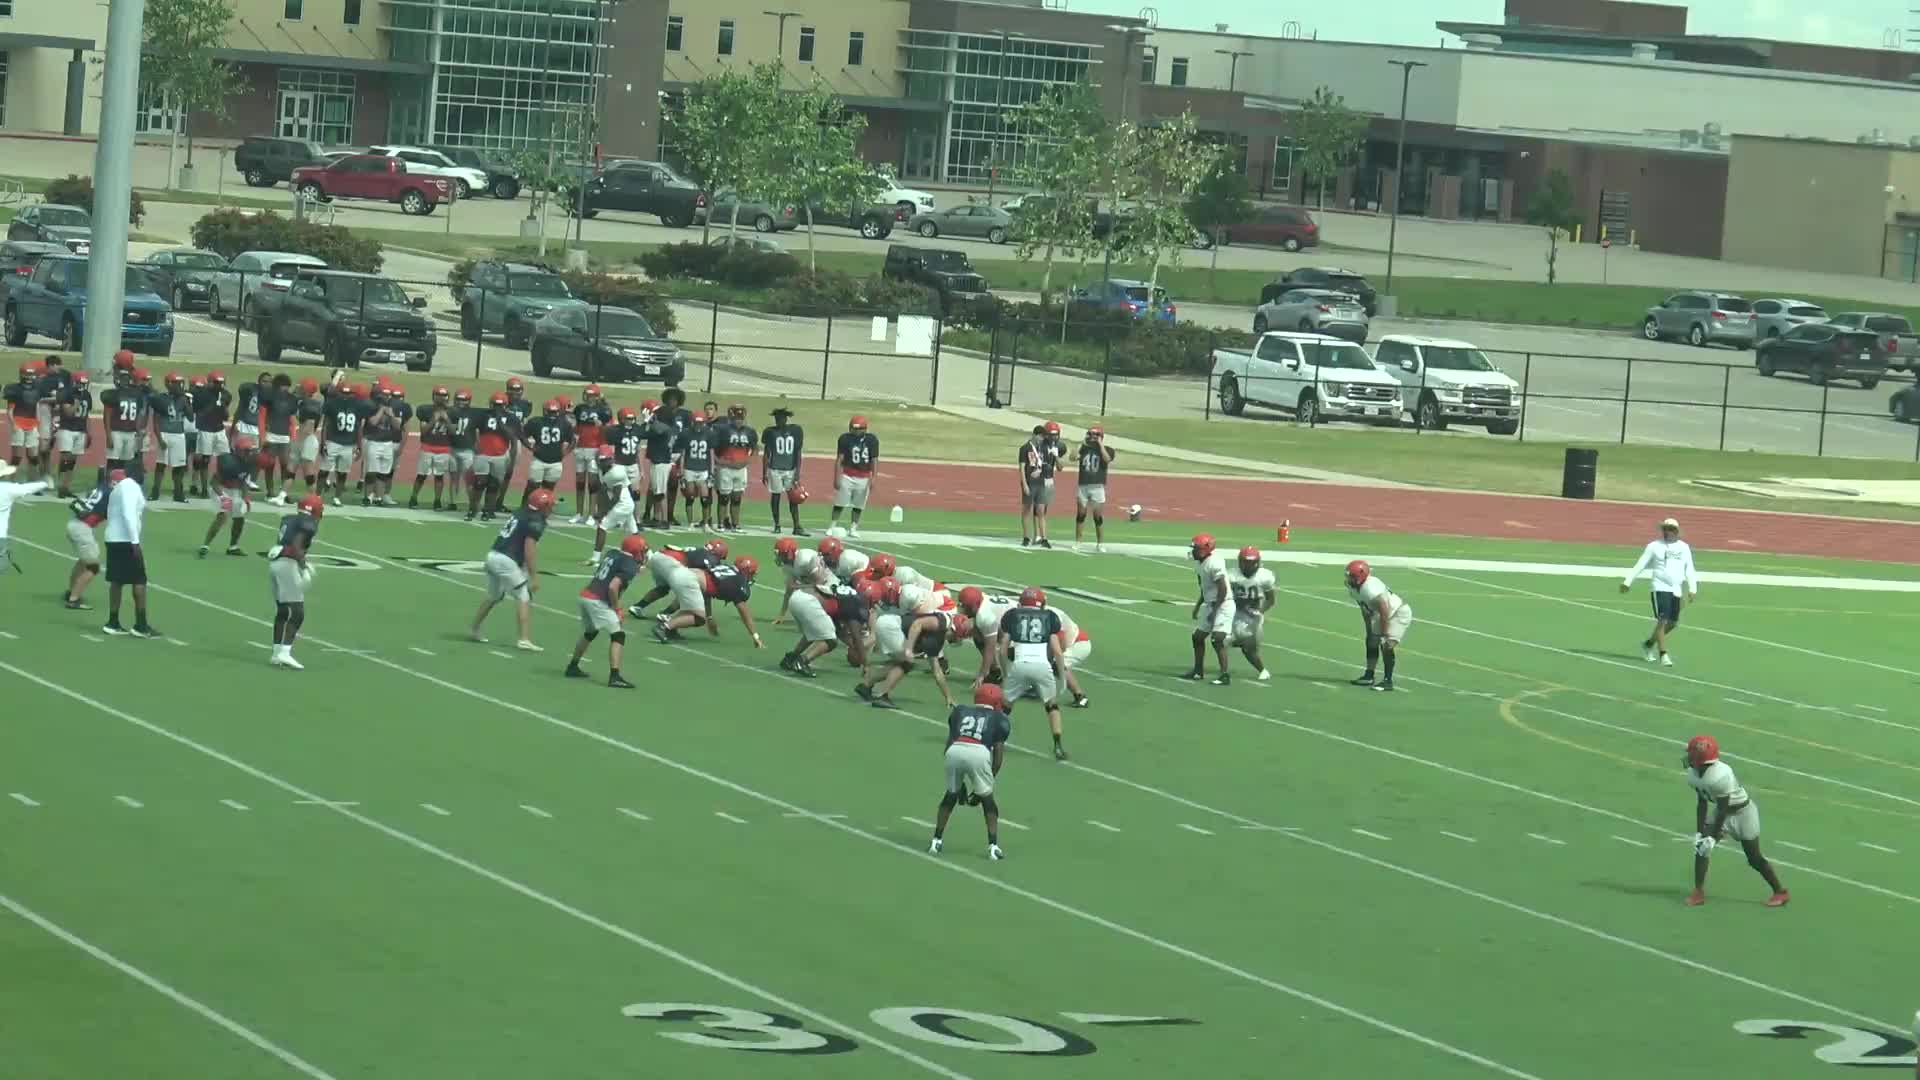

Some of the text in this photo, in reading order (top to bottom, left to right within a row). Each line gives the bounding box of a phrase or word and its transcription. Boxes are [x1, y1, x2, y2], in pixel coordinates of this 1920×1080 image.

[119, 400, 137, 421] 76
[336, 411, 357, 433] 39
[689, 439, 708, 460] 22
[775, 435, 795, 455] 00
[851, 446, 870, 465] 64
[1082, 453, 1101, 473] 40
[1019, 617, 1043, 642] 12
[959, 715, 986, 741] 21
